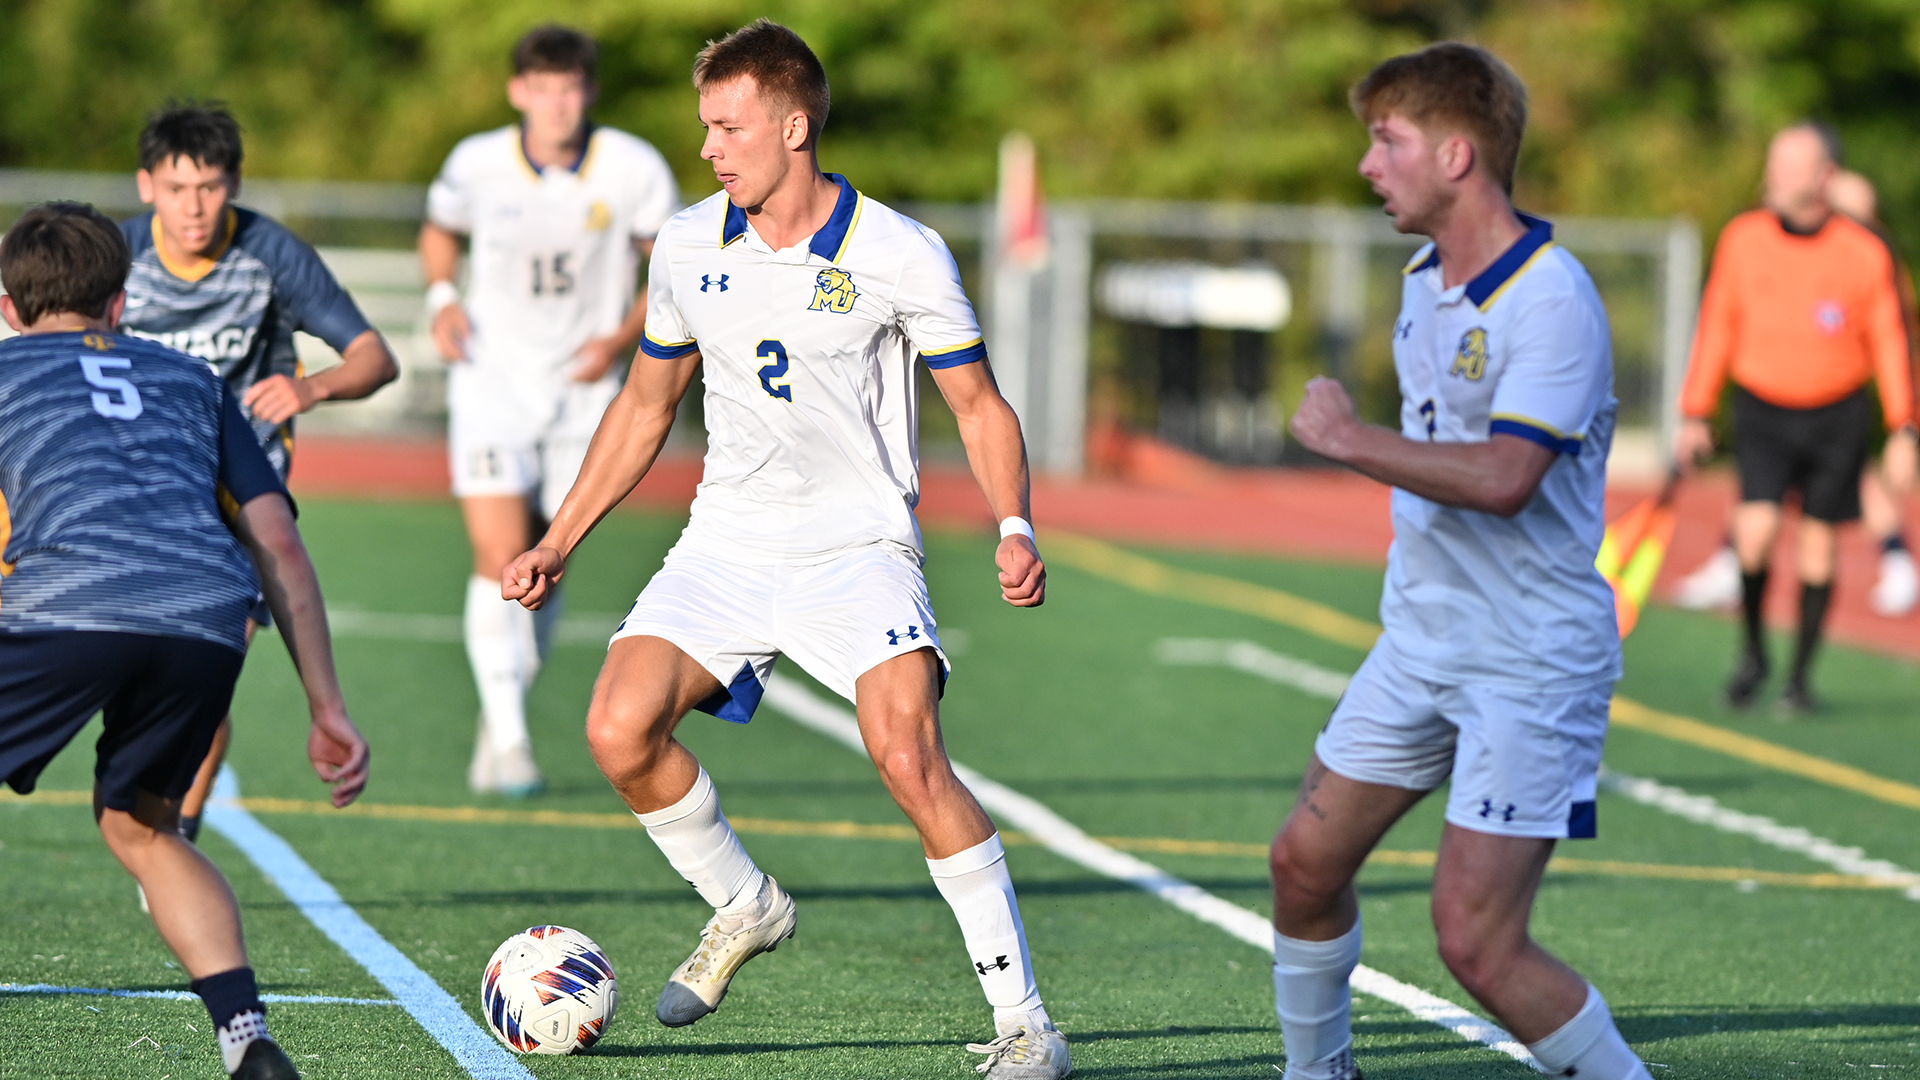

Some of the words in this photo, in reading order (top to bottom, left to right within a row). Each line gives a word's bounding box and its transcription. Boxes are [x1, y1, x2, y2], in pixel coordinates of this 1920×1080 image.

[530, 252, 576, 297] 15
[807, 285, 861, 314] MU
[79, 355, 143, 421] 5
[755, 338, 794, 404] 2
[1449, 350, 1489, 381] MU
